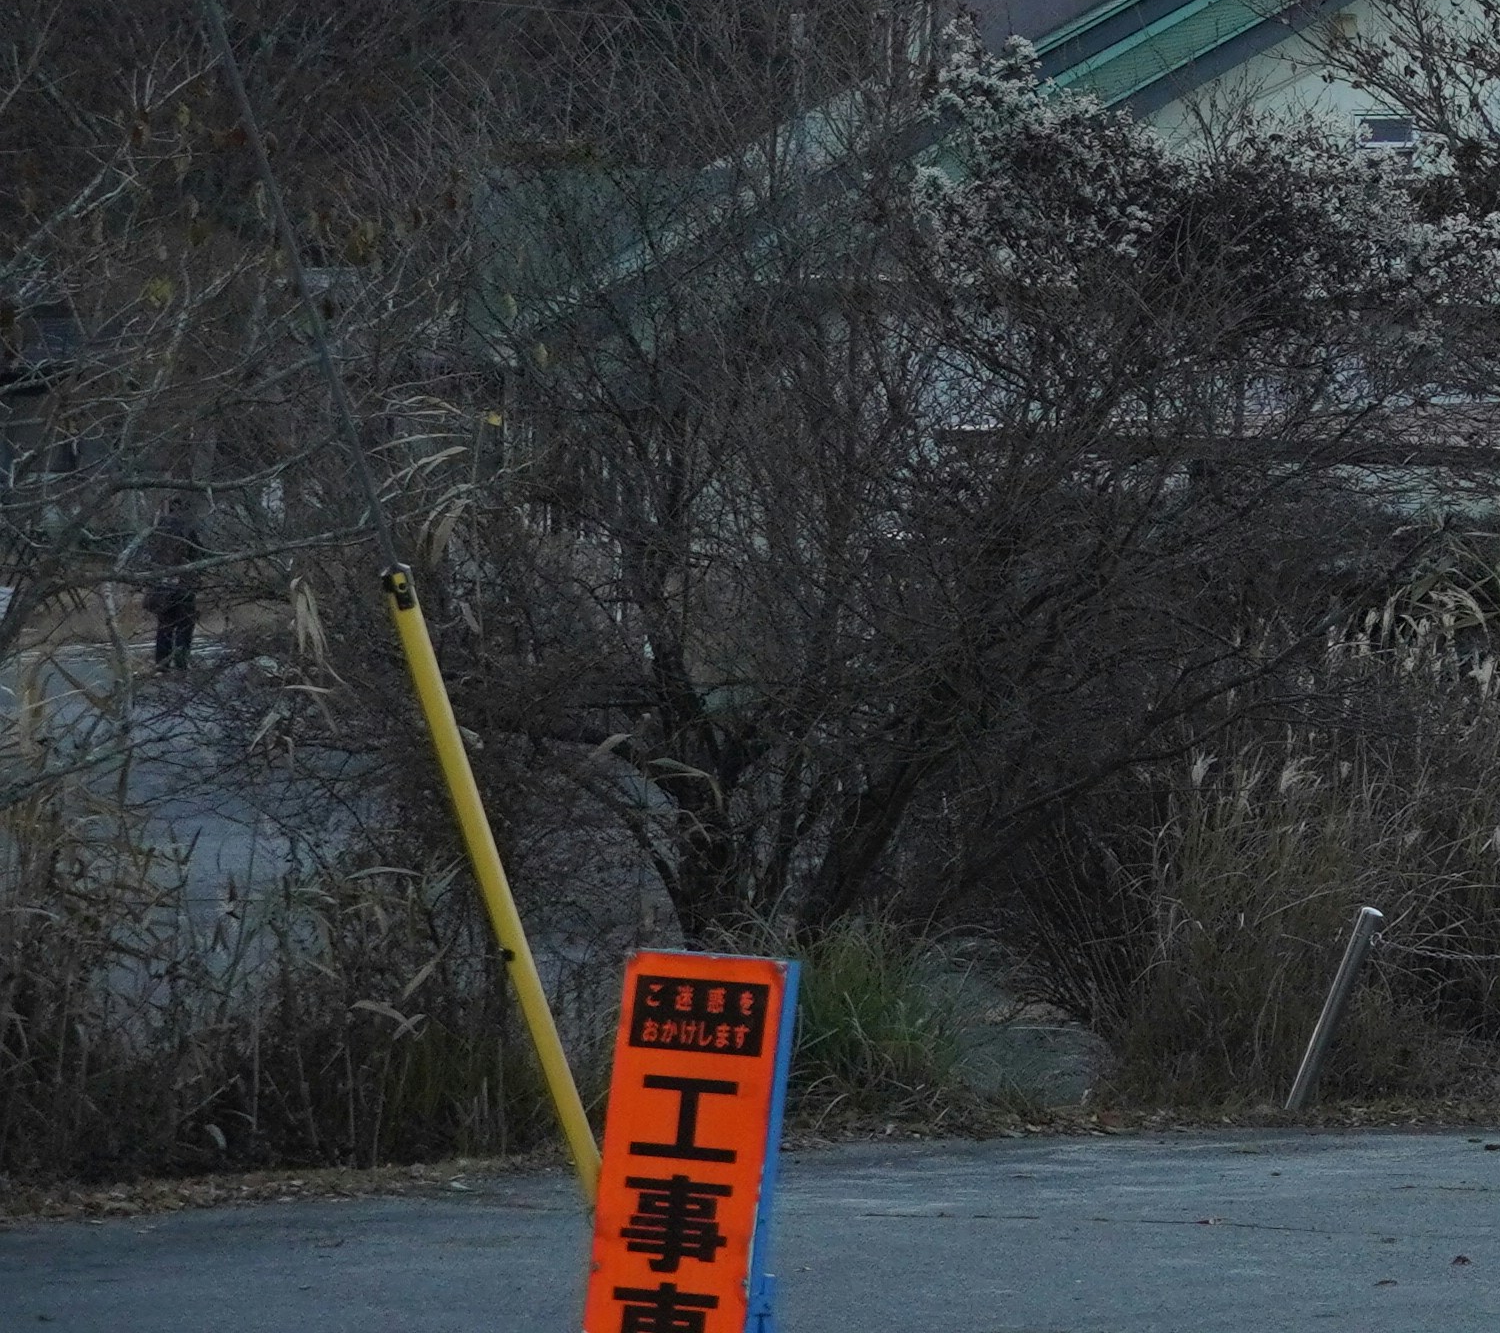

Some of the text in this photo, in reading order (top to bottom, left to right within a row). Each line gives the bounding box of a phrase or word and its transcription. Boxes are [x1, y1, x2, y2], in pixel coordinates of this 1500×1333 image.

[645, 982, 756, 1016] ご迷惑を
[640, 1021, 751, 1050] おかけします
